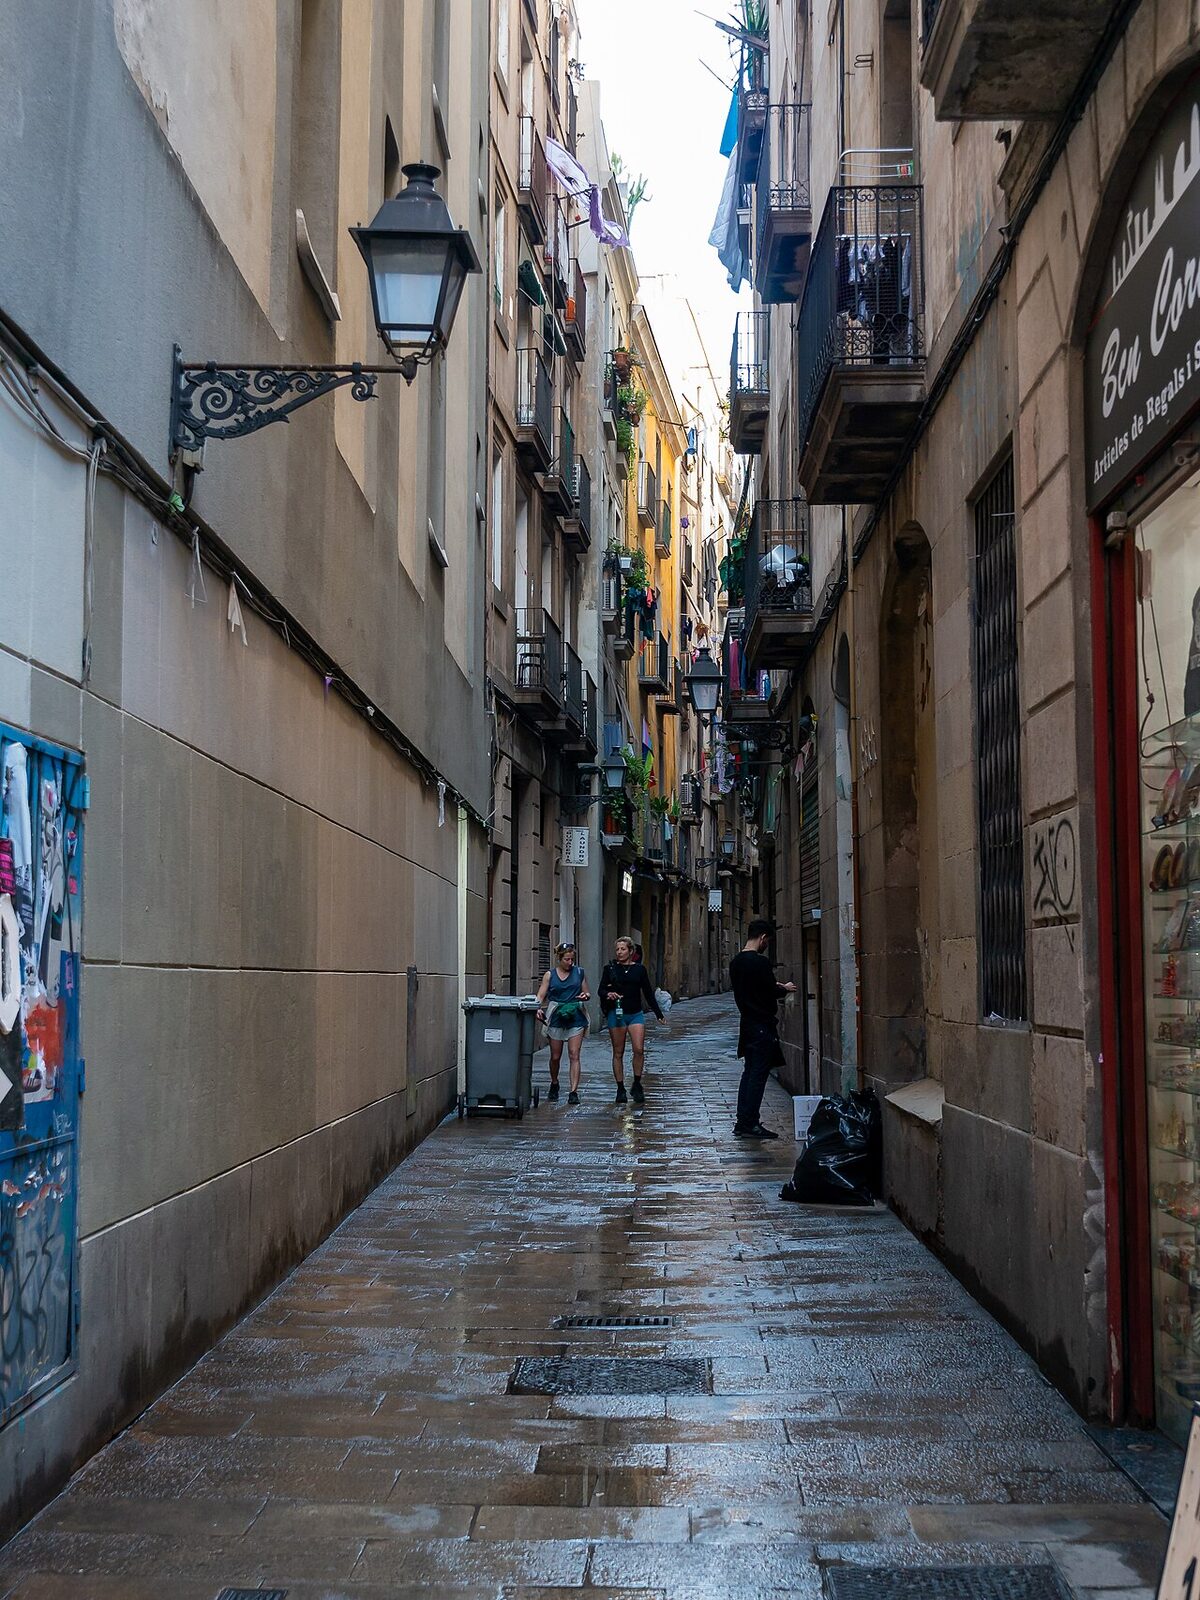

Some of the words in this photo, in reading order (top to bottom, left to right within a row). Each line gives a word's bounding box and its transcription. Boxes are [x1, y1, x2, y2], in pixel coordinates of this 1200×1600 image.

[1093, 431, 1129, 485] Articles
[1131, 414, 1144, 441] de
[1146, 367, 1185, 425] Regals
[1186, 352, 1192, 380] i
[1101, 327, 1141, 418] Bcn
